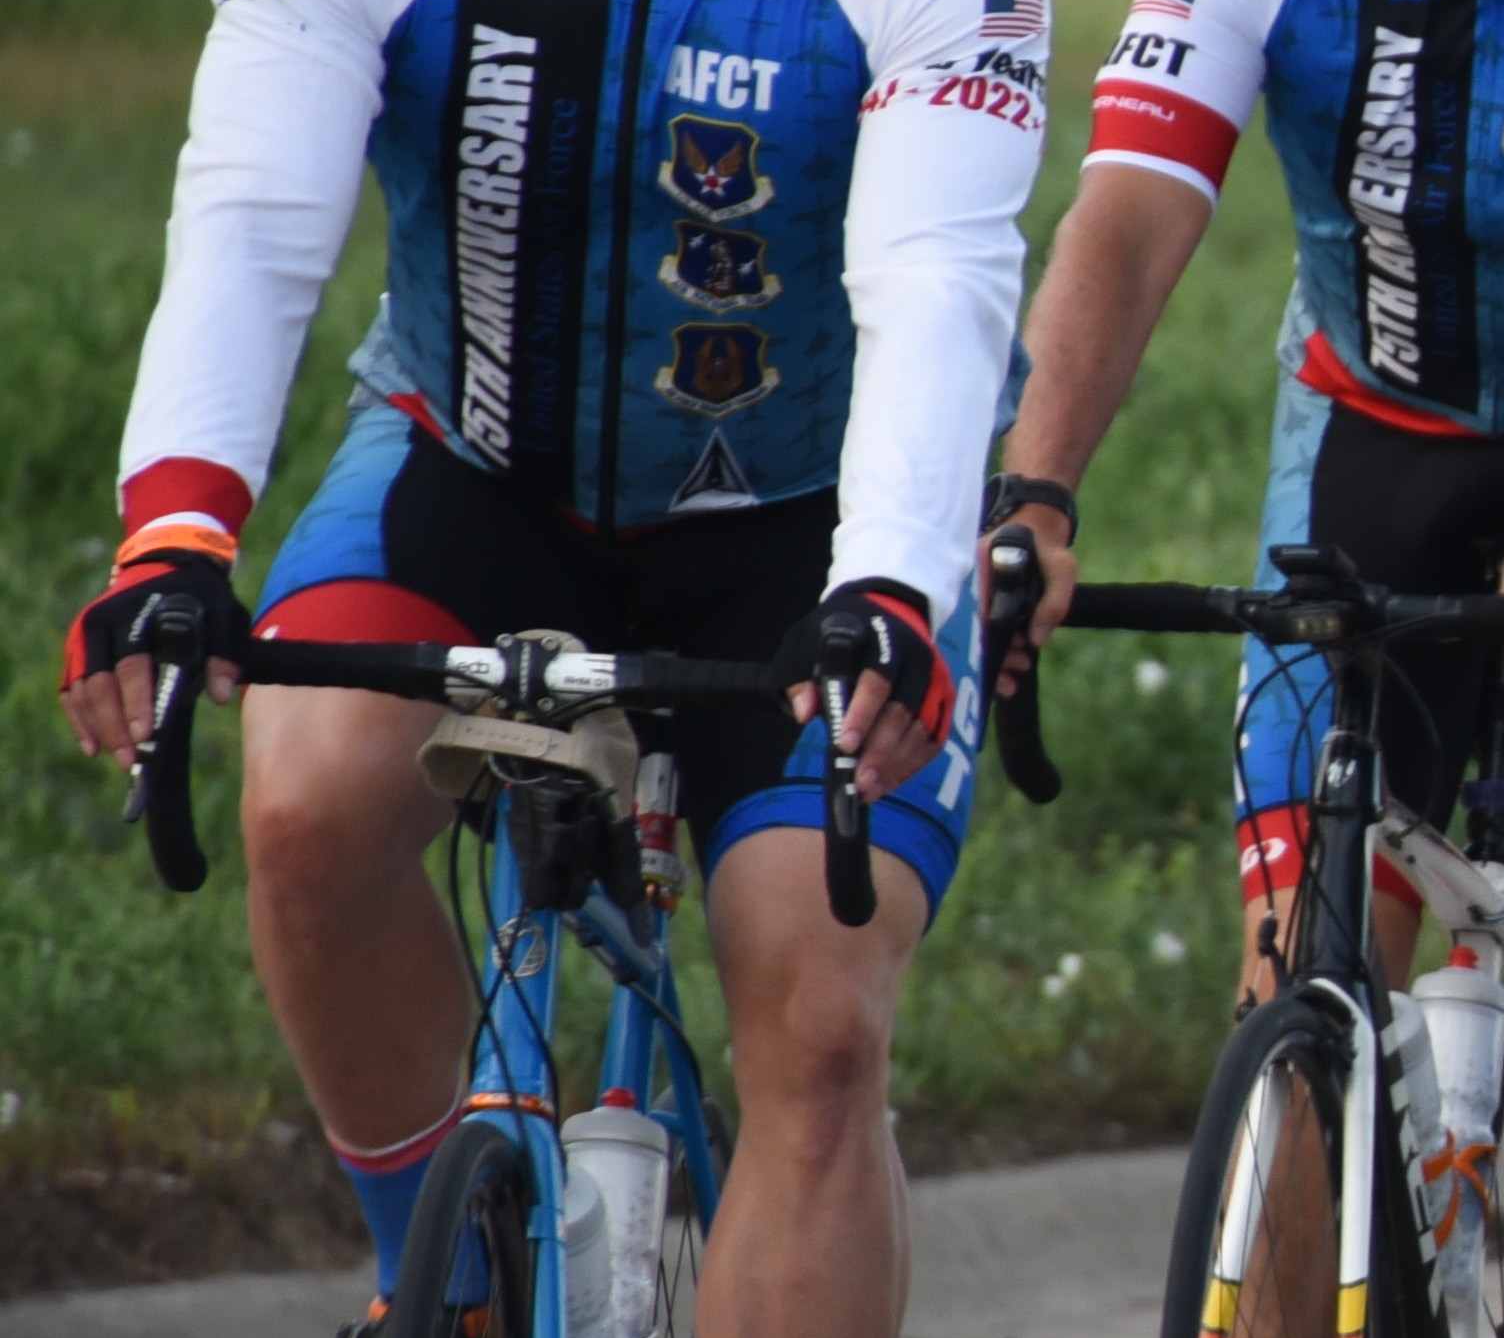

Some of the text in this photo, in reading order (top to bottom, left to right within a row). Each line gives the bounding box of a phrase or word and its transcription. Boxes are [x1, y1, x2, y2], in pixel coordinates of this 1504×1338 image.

[664, 44, 781, 111] AFCT
[1102, 31, 1197, 77] FCT
[928, 76, 1030, 131] 2022
[535, 97, 580, 196] Force
[456, 23, 538, 467] 75TH ANNIVERSARY
[1367, 273, 1421, 384] 75TH
